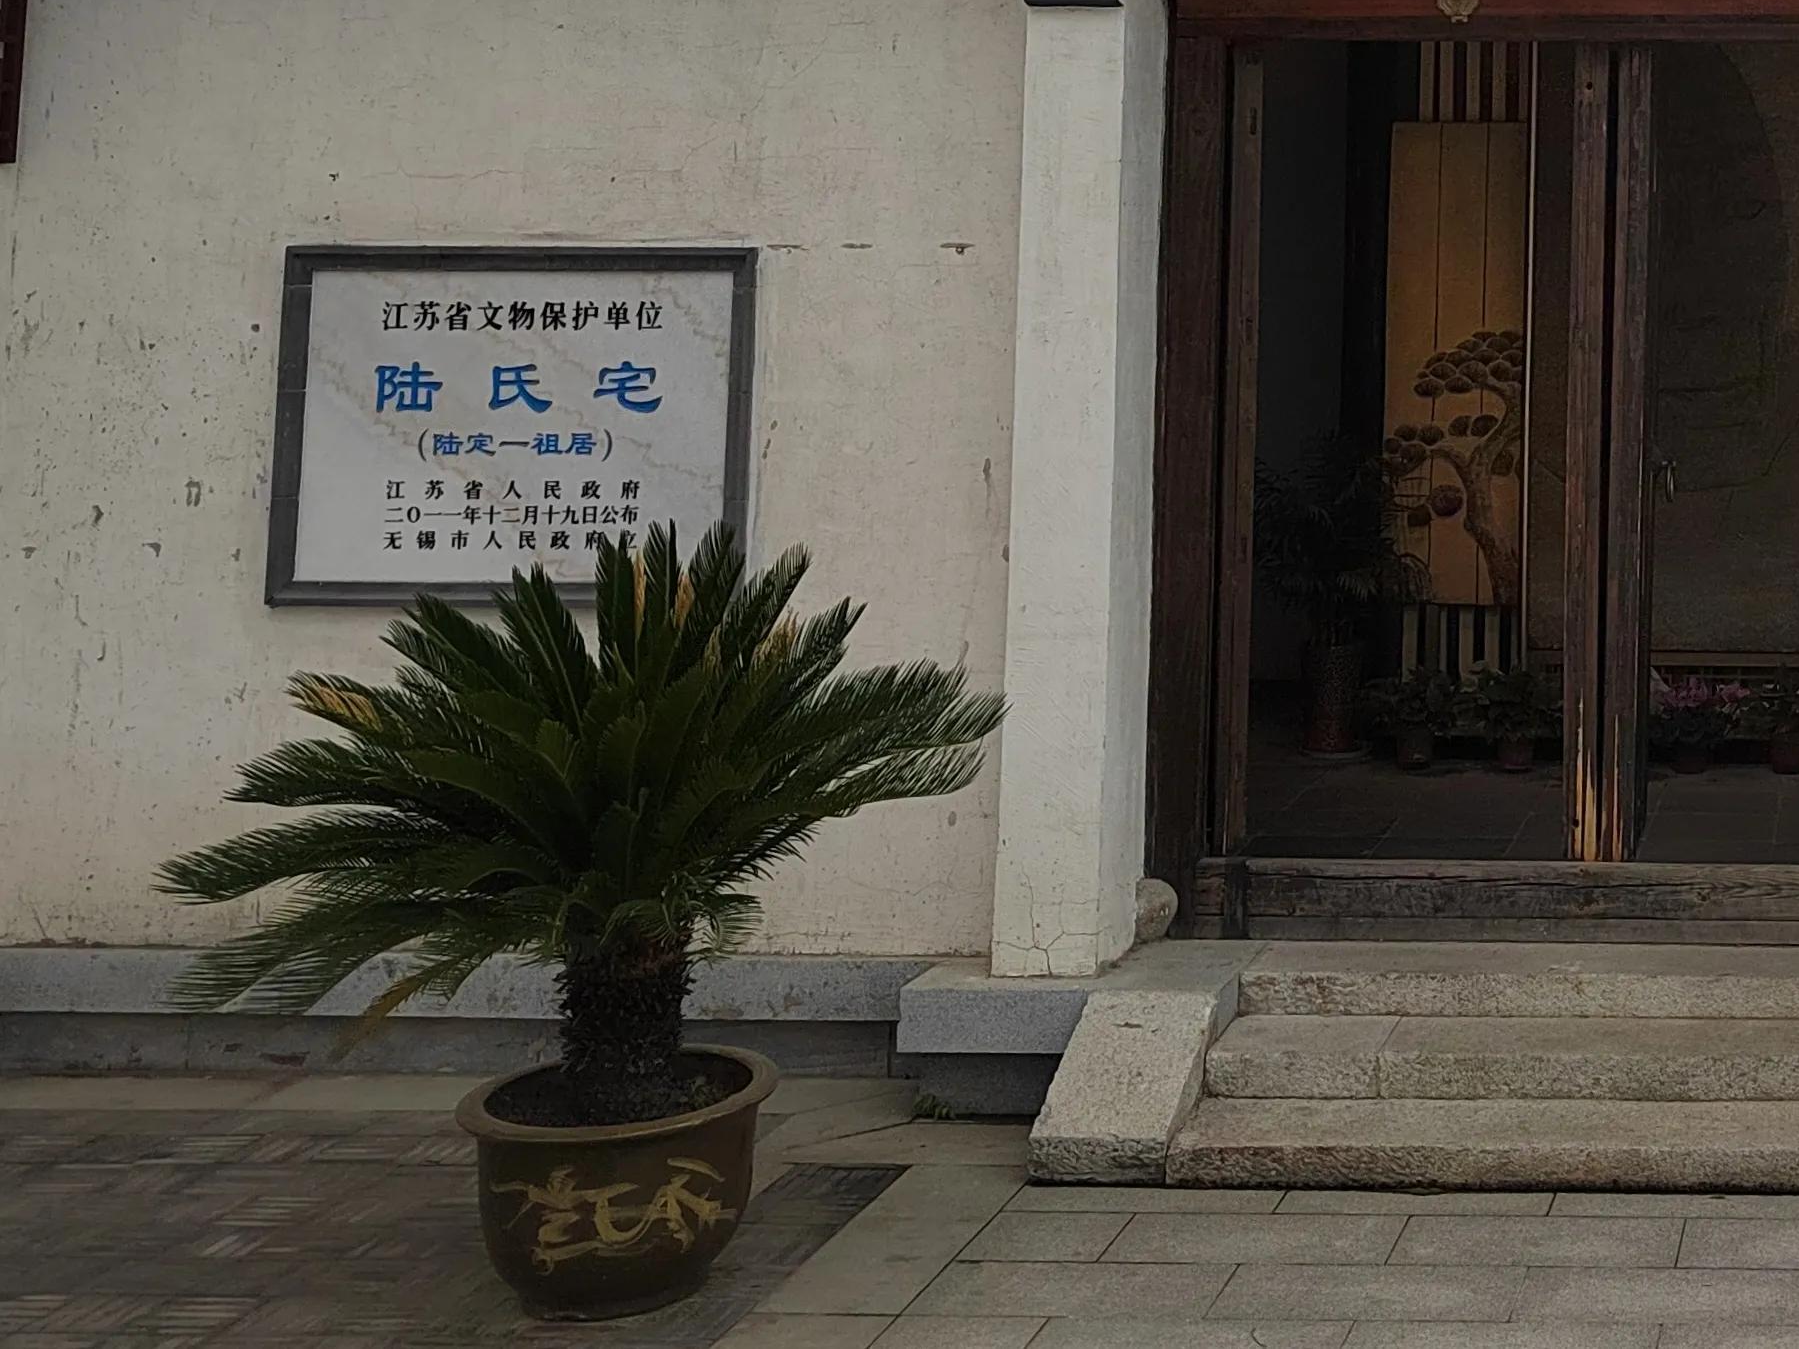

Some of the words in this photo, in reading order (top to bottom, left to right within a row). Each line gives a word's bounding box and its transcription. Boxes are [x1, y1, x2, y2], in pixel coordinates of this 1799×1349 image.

[382, 301, 663, 331] 江苏省文物保护单位
[374, 360, 664, 414] 陆氏宅
[385, 480, 640, 500] 江苏省人民政府
